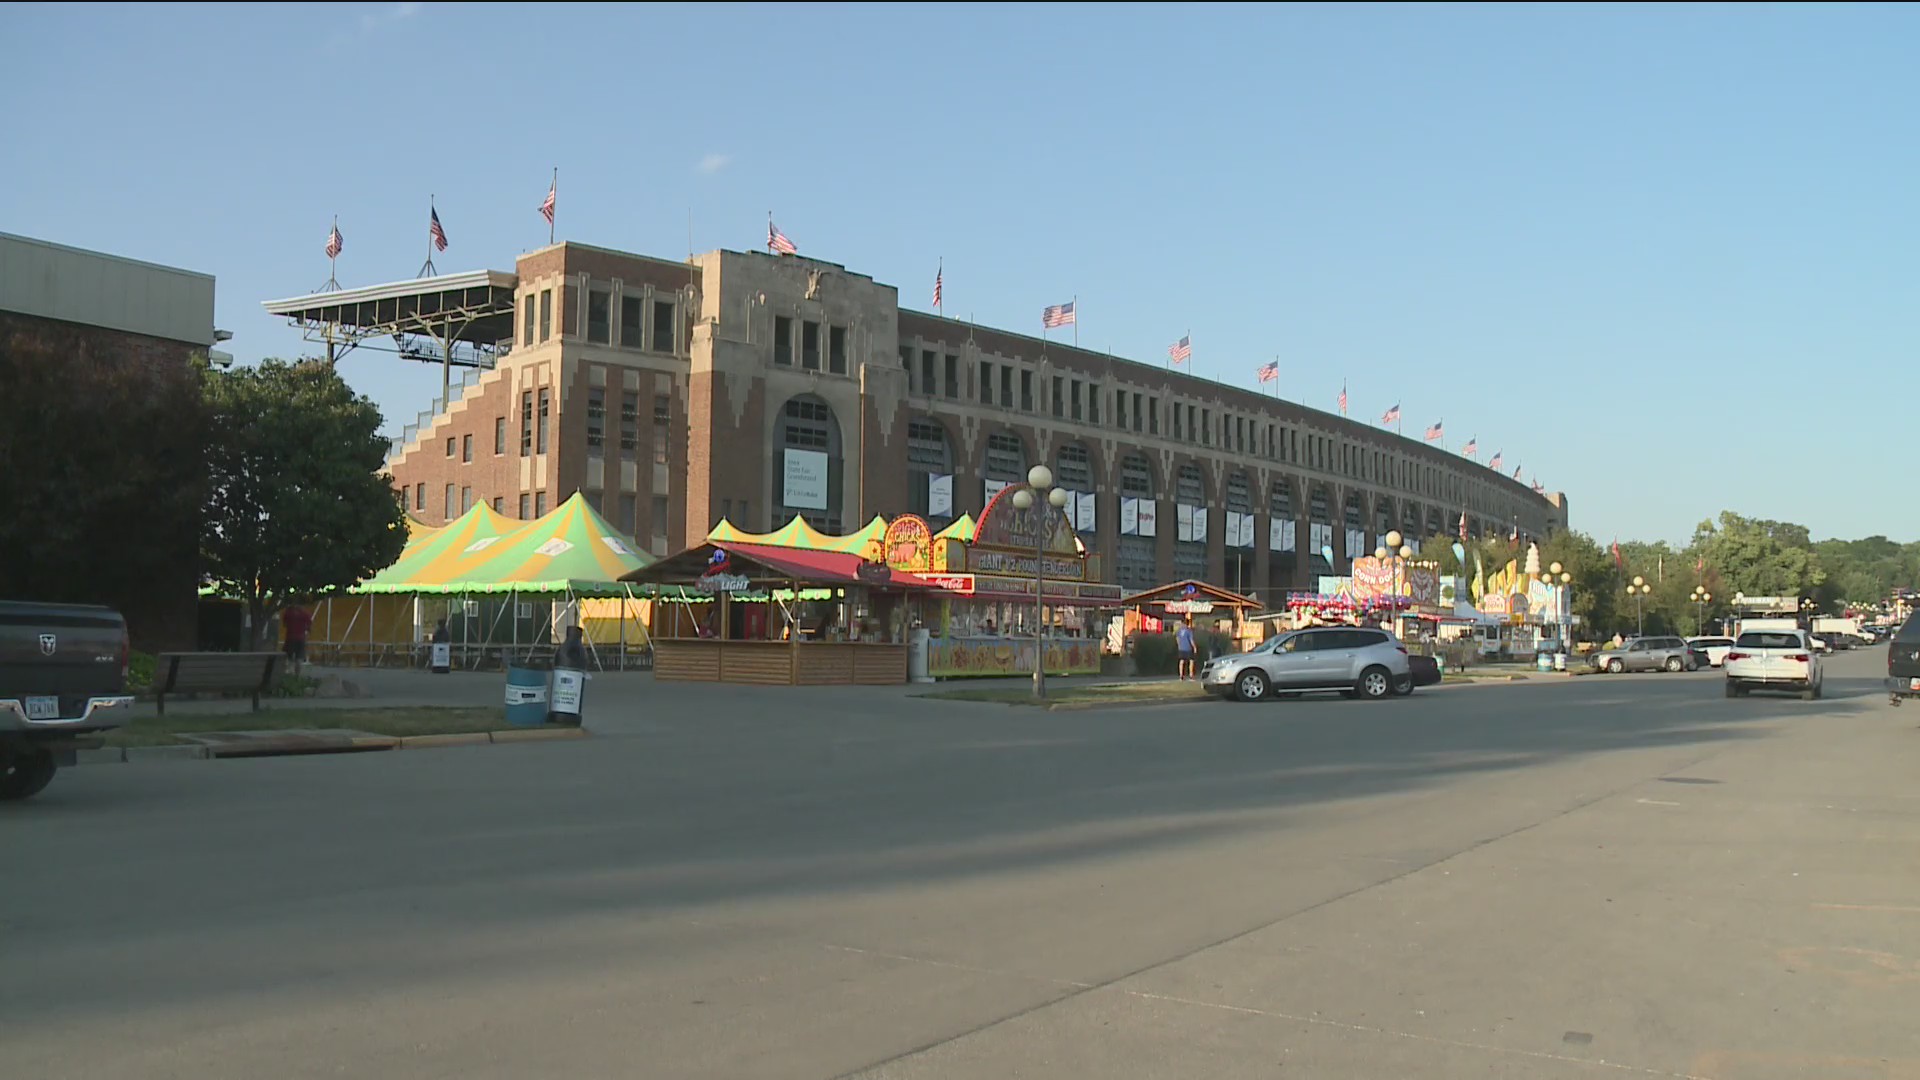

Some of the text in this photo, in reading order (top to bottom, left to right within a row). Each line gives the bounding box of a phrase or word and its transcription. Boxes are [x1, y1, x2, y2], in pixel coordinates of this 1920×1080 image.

[979, 554, 1003, 570] GIANT
[1018, 559, 1040, 573] POUN
[1355, 568, 1376, 584] CORN
[721, 580, 750, 590] LIGHT
